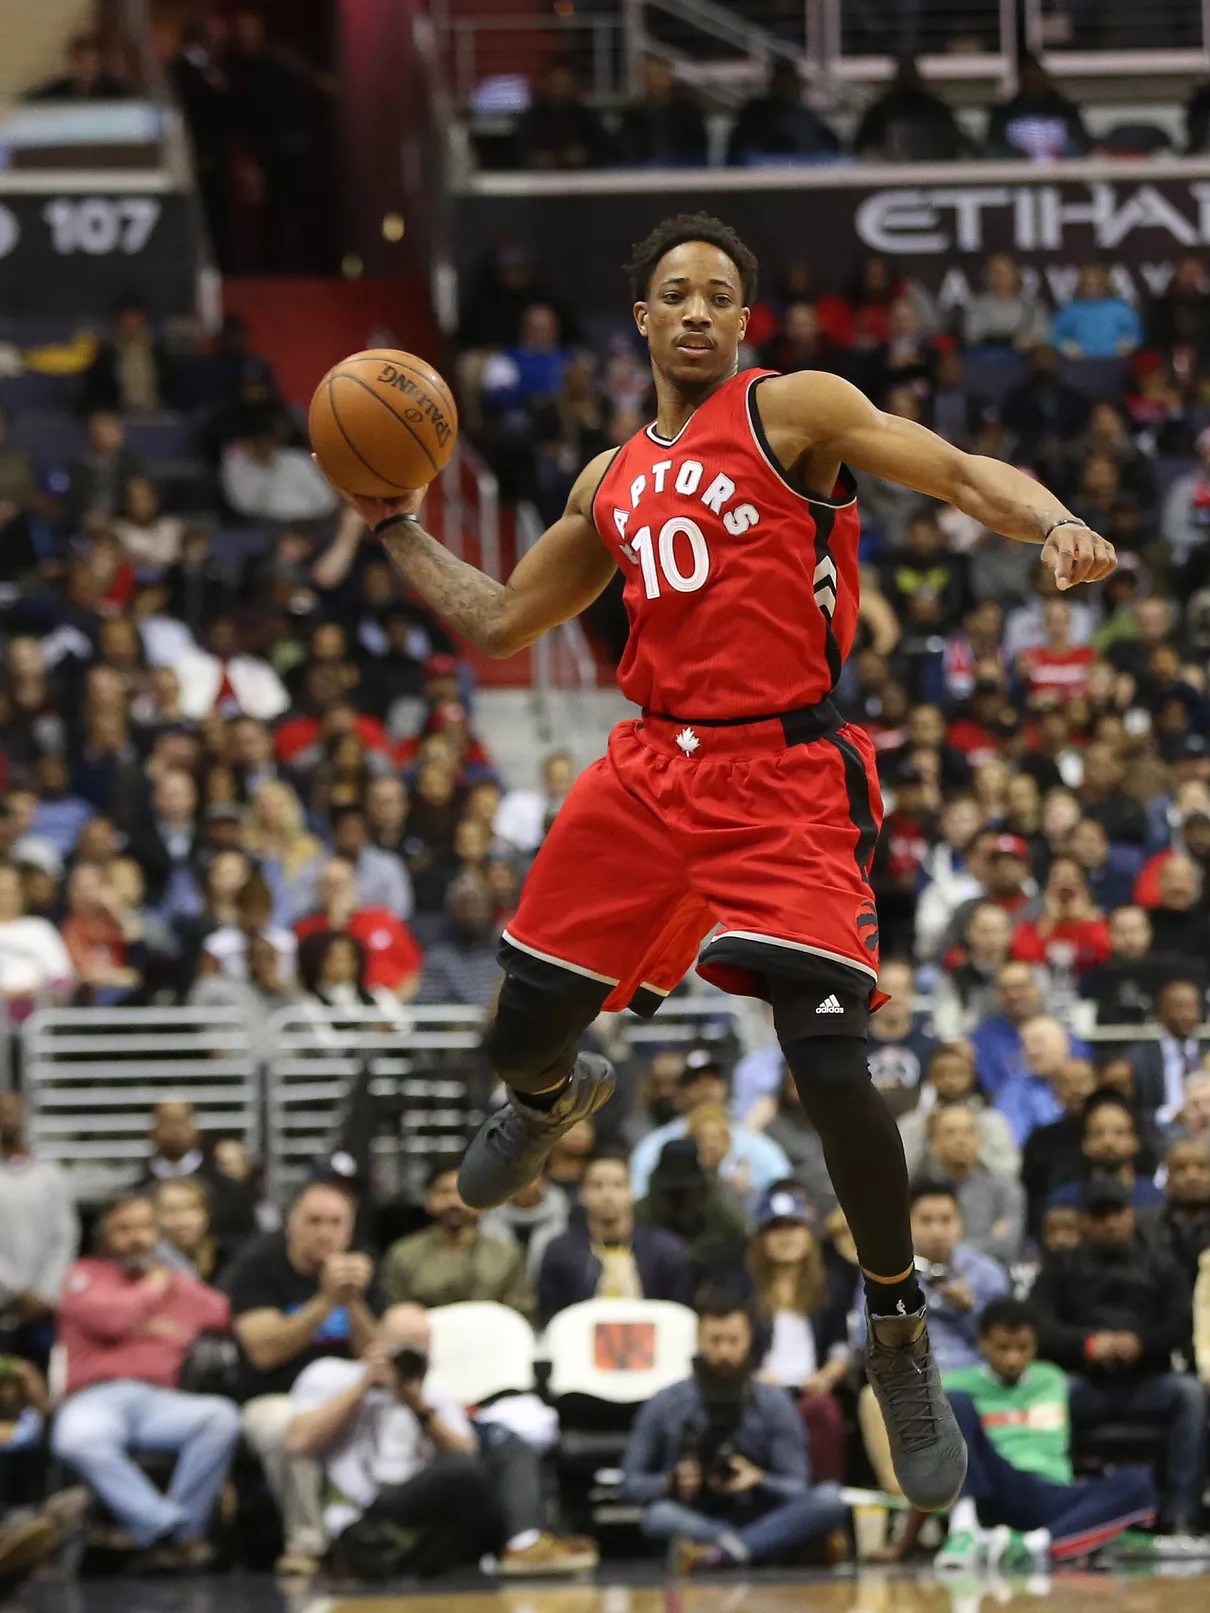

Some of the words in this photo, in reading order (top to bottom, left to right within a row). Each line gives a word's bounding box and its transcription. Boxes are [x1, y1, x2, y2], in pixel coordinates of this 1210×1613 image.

[41, 198, 161, 254] 107
[630, 516, 710, 600] 10
[815, 1004, 845, 1014] adidas
